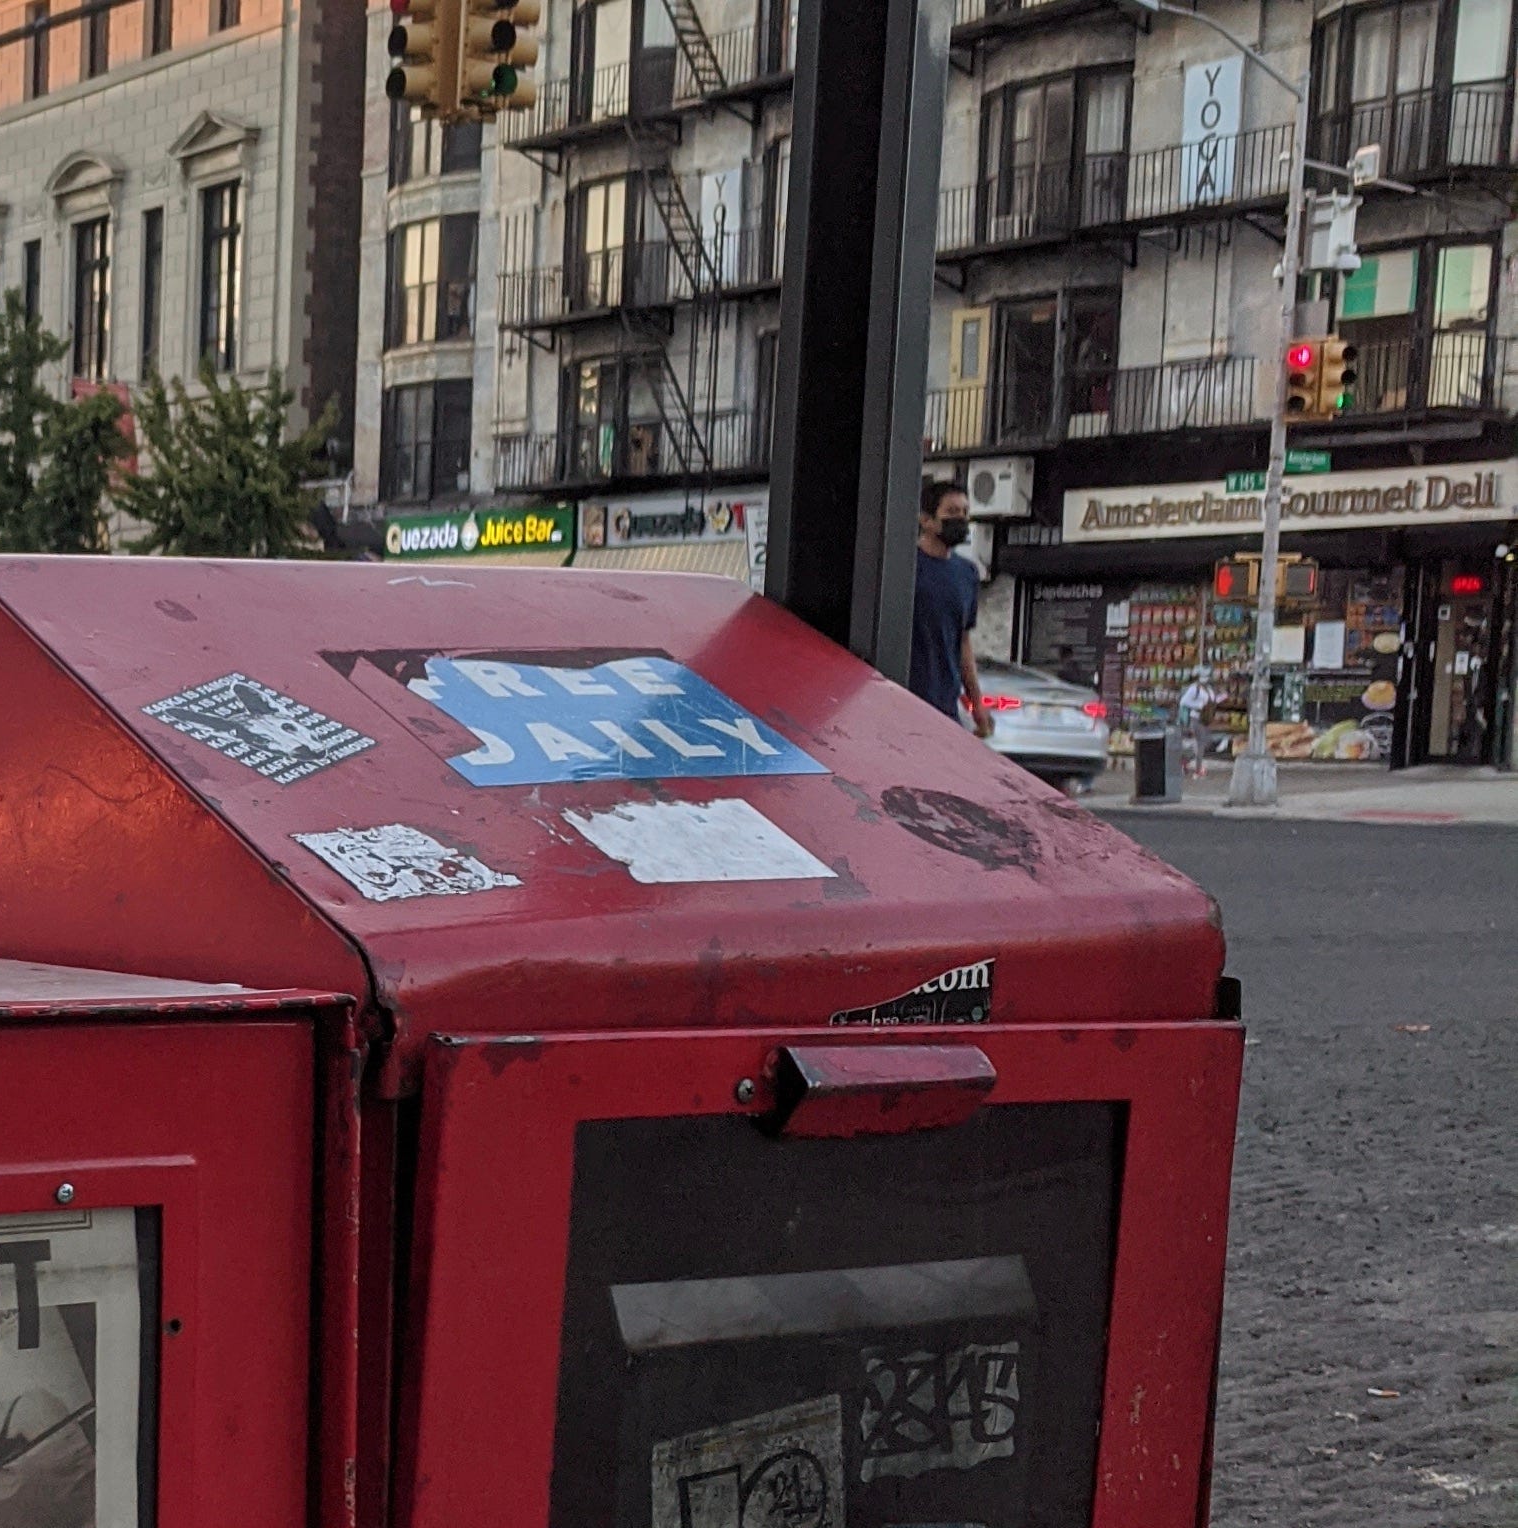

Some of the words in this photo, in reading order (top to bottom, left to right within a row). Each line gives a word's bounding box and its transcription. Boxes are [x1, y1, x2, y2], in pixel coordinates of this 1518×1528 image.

[1195, 65, 1223, 194] YOGA
[1082, 492, 1264, 530] Amsterdam
[1281, 480, 1422, 519] ourmet
[1426, 471, 1498, 512] Deli
[386, 520, 459, 555] Quezada
[481, 517, 524, 547] Juice
[525, 514, 556, 543] Bar
[141, 695, 189, 716] KAFKA
[182, 690, 200, 700] IS
[195, 672, 246, 695] FAMOUS
[274, 762, 320, 784] KAFKA
[330, 737, 376, 761] FAMOUS
